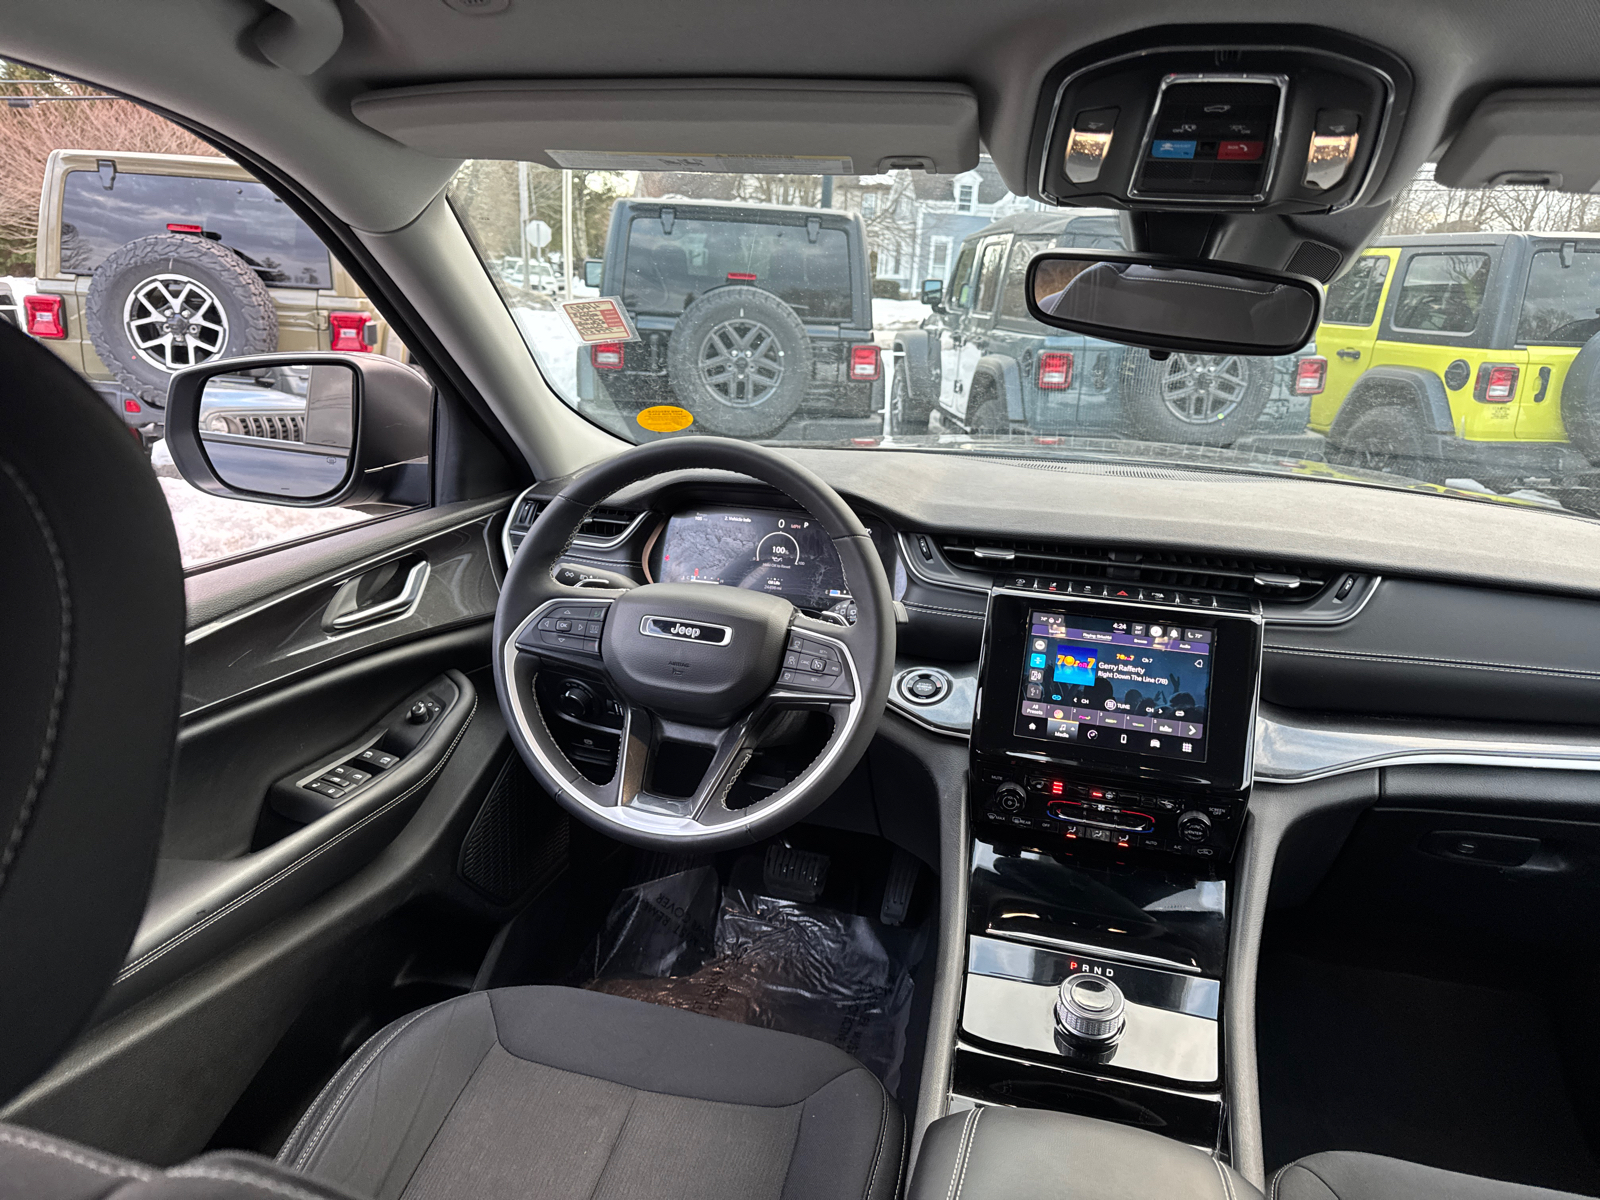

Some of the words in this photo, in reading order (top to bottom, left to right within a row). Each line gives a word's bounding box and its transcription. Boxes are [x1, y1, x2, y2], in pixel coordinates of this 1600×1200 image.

[778, 519, 785, 529] 0
[670, 623, 701, 638] Jeep
[1112, 622, 1127, 630] 4:24
[667, 660, 690, 668] AIRBAG
[1098, 662, 1118, 671] Gerry
[1118, 664, 1145, 675] Rafferty
[1097, 670, 1113, 679] Right
[1113, 672, 1131, 680] Down
[1131, 674, 1142, 682] The
[655, 893, 692, 924] COVER
[1070, 961, 1077, 969] P
[1082, 964, 1089, 972] R
[1094, 966, 1101, 974] N
[1106, 968, 1113, 977] D
